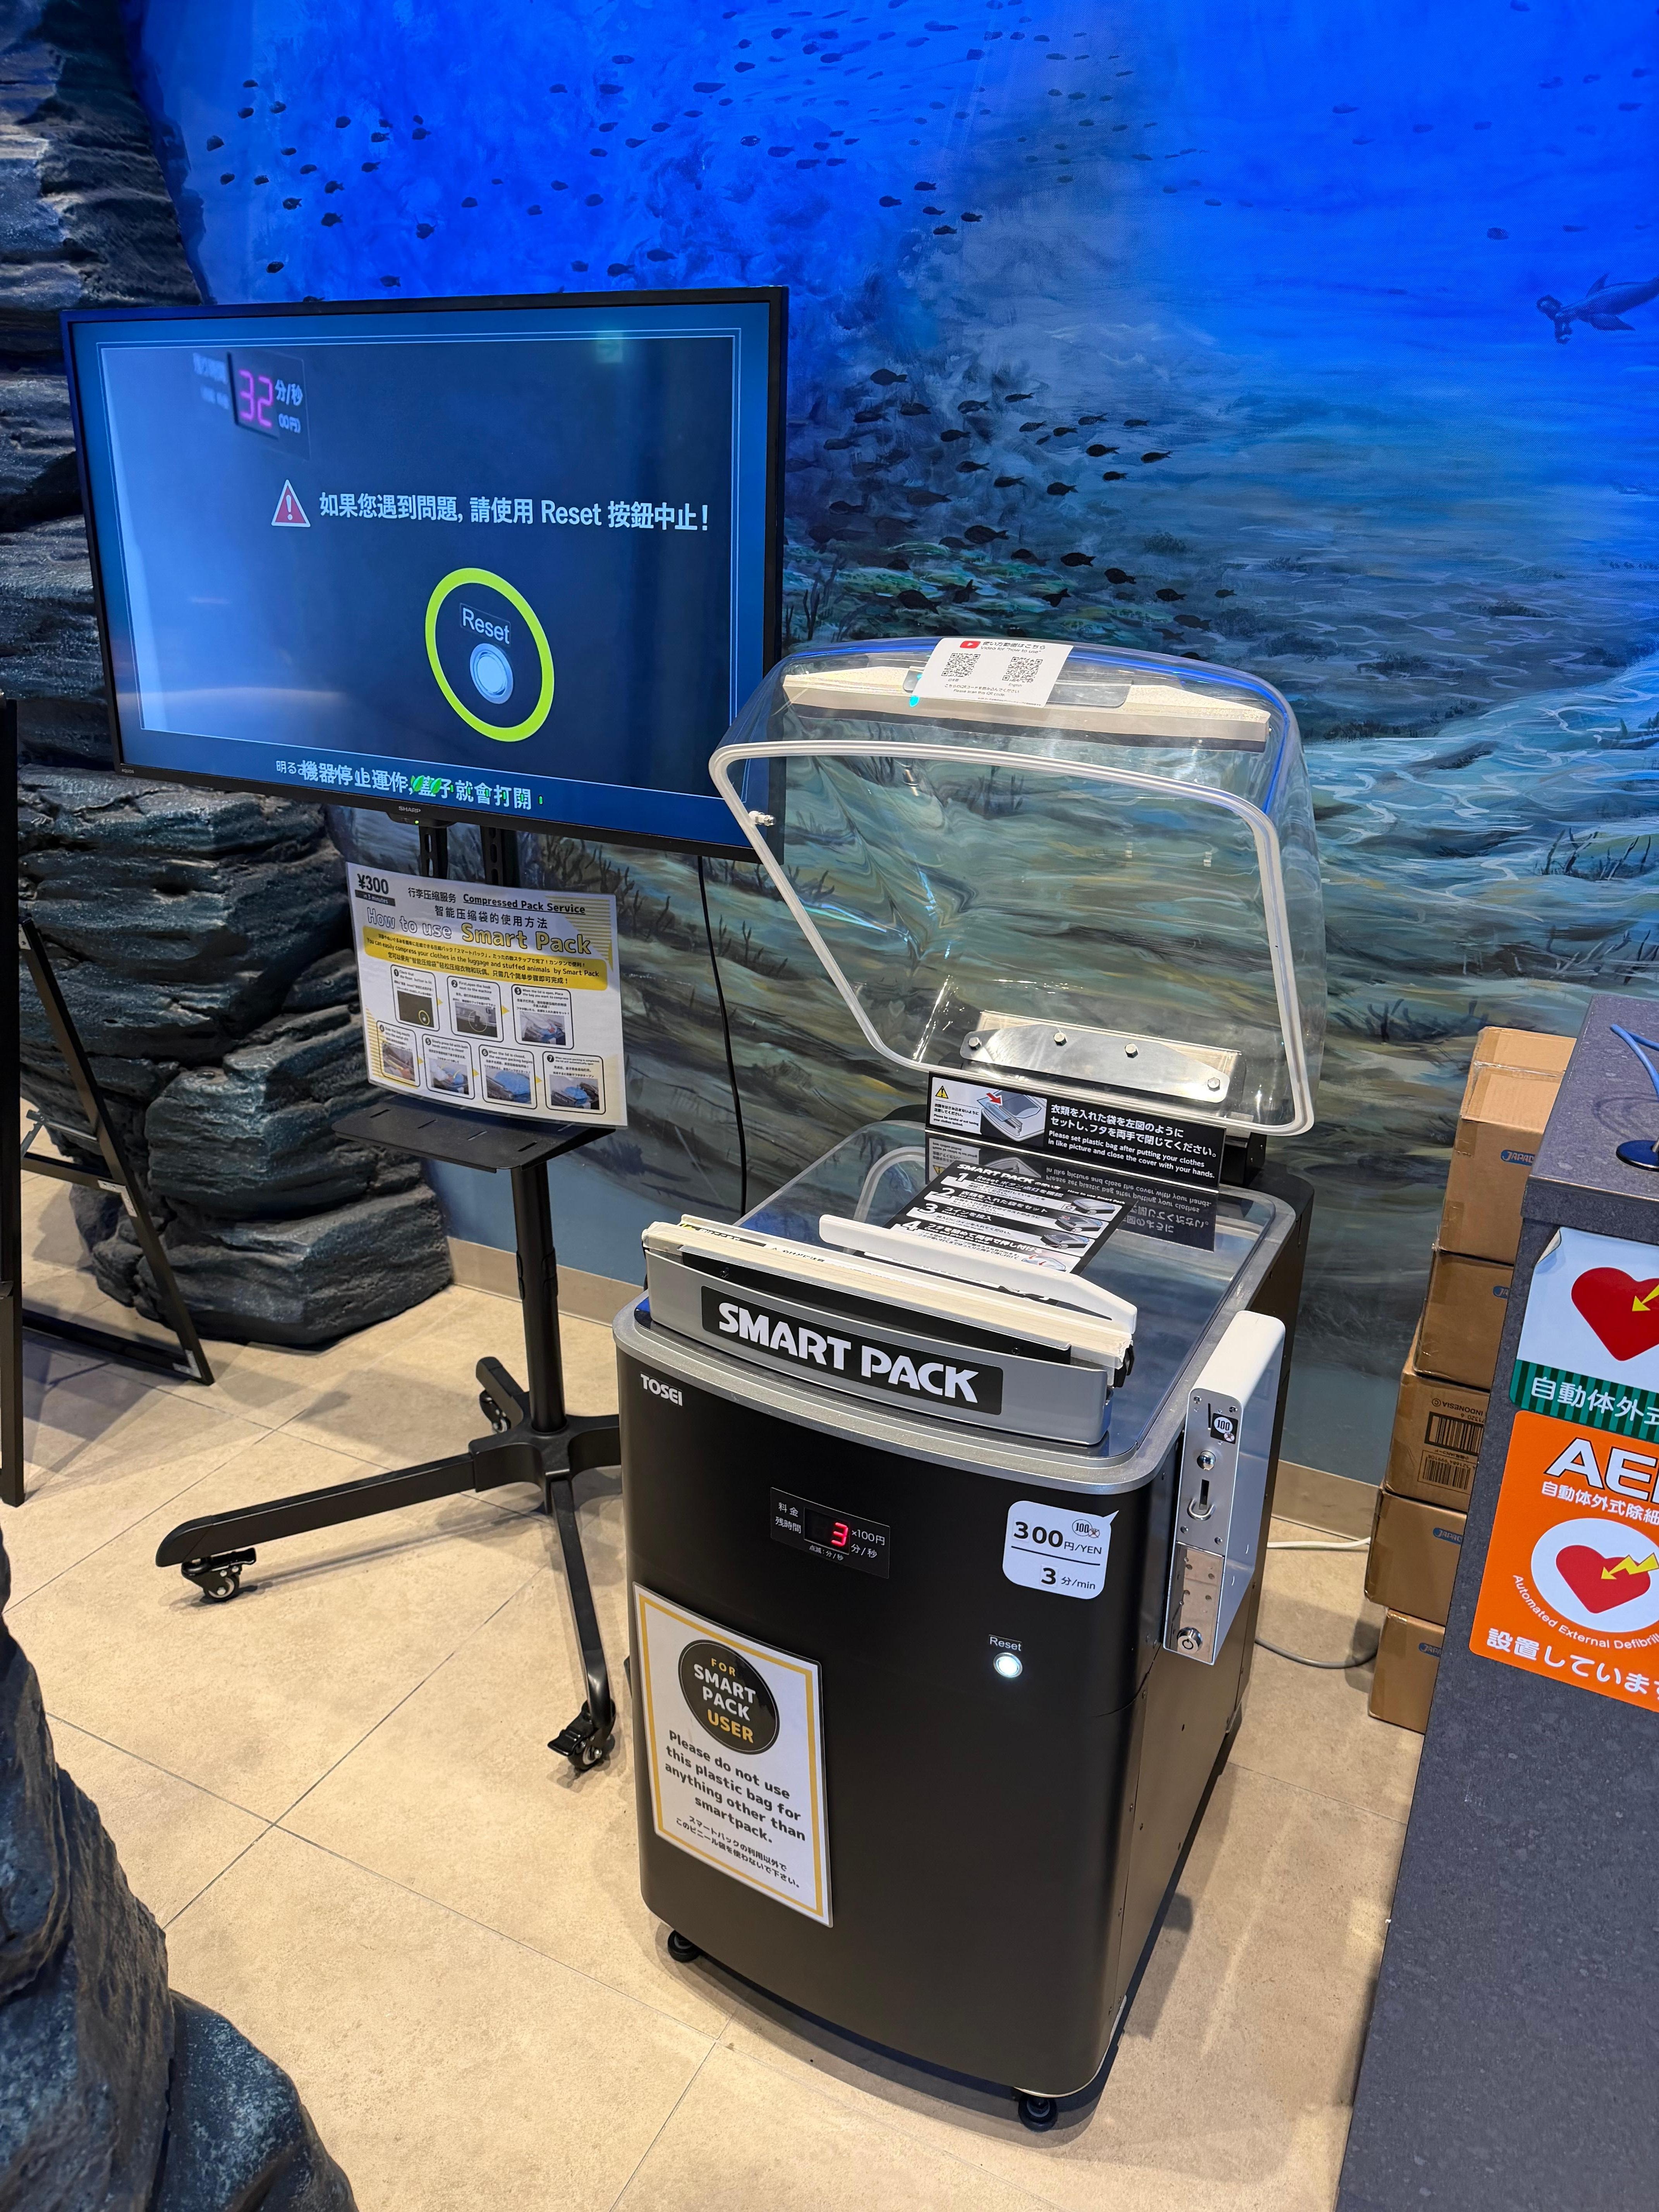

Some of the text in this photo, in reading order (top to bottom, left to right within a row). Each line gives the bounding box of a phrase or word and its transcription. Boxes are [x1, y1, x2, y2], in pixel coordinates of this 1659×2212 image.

[239, 369, 273, 428] 32
[469, 496, 533, 524] 請使用
[541, 500, 602, 526] Reset
[462, 607, 510, 644] Reset
[357, 873, 389, 895] ¥300
[408, 887, 457, 903] 行李压缩服务
[434, 905, 548, 929] 智能压缩袋的使用方法
[463, 893, 586, 914] Compressed Pack Service
[367, 907, 592, 954] How to use Smart Pack
[395, 946, 417, 955] compress
[430, 951, 450, 960] clothes
[467, 957, 489, 967] luggage
[502, 962, 526, 970] stuffed
[1051, 1104, 1184, 1138] 衣類を入れた袋を左図のように
[1051, 1116, 1216, 1158] セットし、フタを両手で閉じてください。
[1049, 1130, 1070, 1140] Please
[1082, 1137, 1104, 1147] plastic
[1105, 1141, 1118, 1151] bag
[1137, 1149, 1161, 1159] putting
[1180, 1157, 1205, 1167] clothes
[1069, 1143, 1092, 1153] picture
[1107, 1151, 1125, 1159] close
[1192, 1168, 1215, 1178] hands.
[957, 1164, 1001, 1176] SMART
[1000, 1173, 1035, 1184] PACK
[957, 1173, 969, 1182] 1
[919, 1203, 938, 1214] 3
[934, 1187, 955, 1198] 2
[902, 1220, 922, 1231] 4
[718, 1302, 979, 1403] SMART PACK
[640, 1373, 683, 1407] TOSEI
[1216, 1420, 1230, 1431] 100
[1442, 1401, 1483, 1417] INDONESIA
[1544, 1437, 1659, 1504] AE
[1541, 1481, 1659, 1526] 自動体外式除細
[775, 1516, 877, 1558] 残時間 分/秒
[778, 1502, 799, 1517] 料金
[831, 1522, 849, 1547] 3
[1013, 1521, 1063, 1548] 300
[1075, 1522, 1089, 1534] 100
[1041, 1567, 1096, 1590] 3 分/min
[1513, 1574, 1558, 1628] Automated
[1558, 1624, 1609, 1649] External
[990, 1636, 1021, 1651] Reset
[711, 1657, 736, 1677] FOR
[1486, 1628, 1659, 1701] 設置していま
[694, 1664, 756, 1704] SMART
[702, 1686, 750, 1721] PACK
[708, 1709, 754, 1743] USER
[669, 1729, 790, 1800] Please do not use
[665, 1745, 801, 1821] this plastic bag for
[665, 1763, 806, 1842] anything other than
[694, 1796, 773, 1843] smartpack.
[676, 1817, 800, 1888] このビニール袋を使わないで下さい。
[689, 1815, 787, 1871] スマートパックの利用以外で
